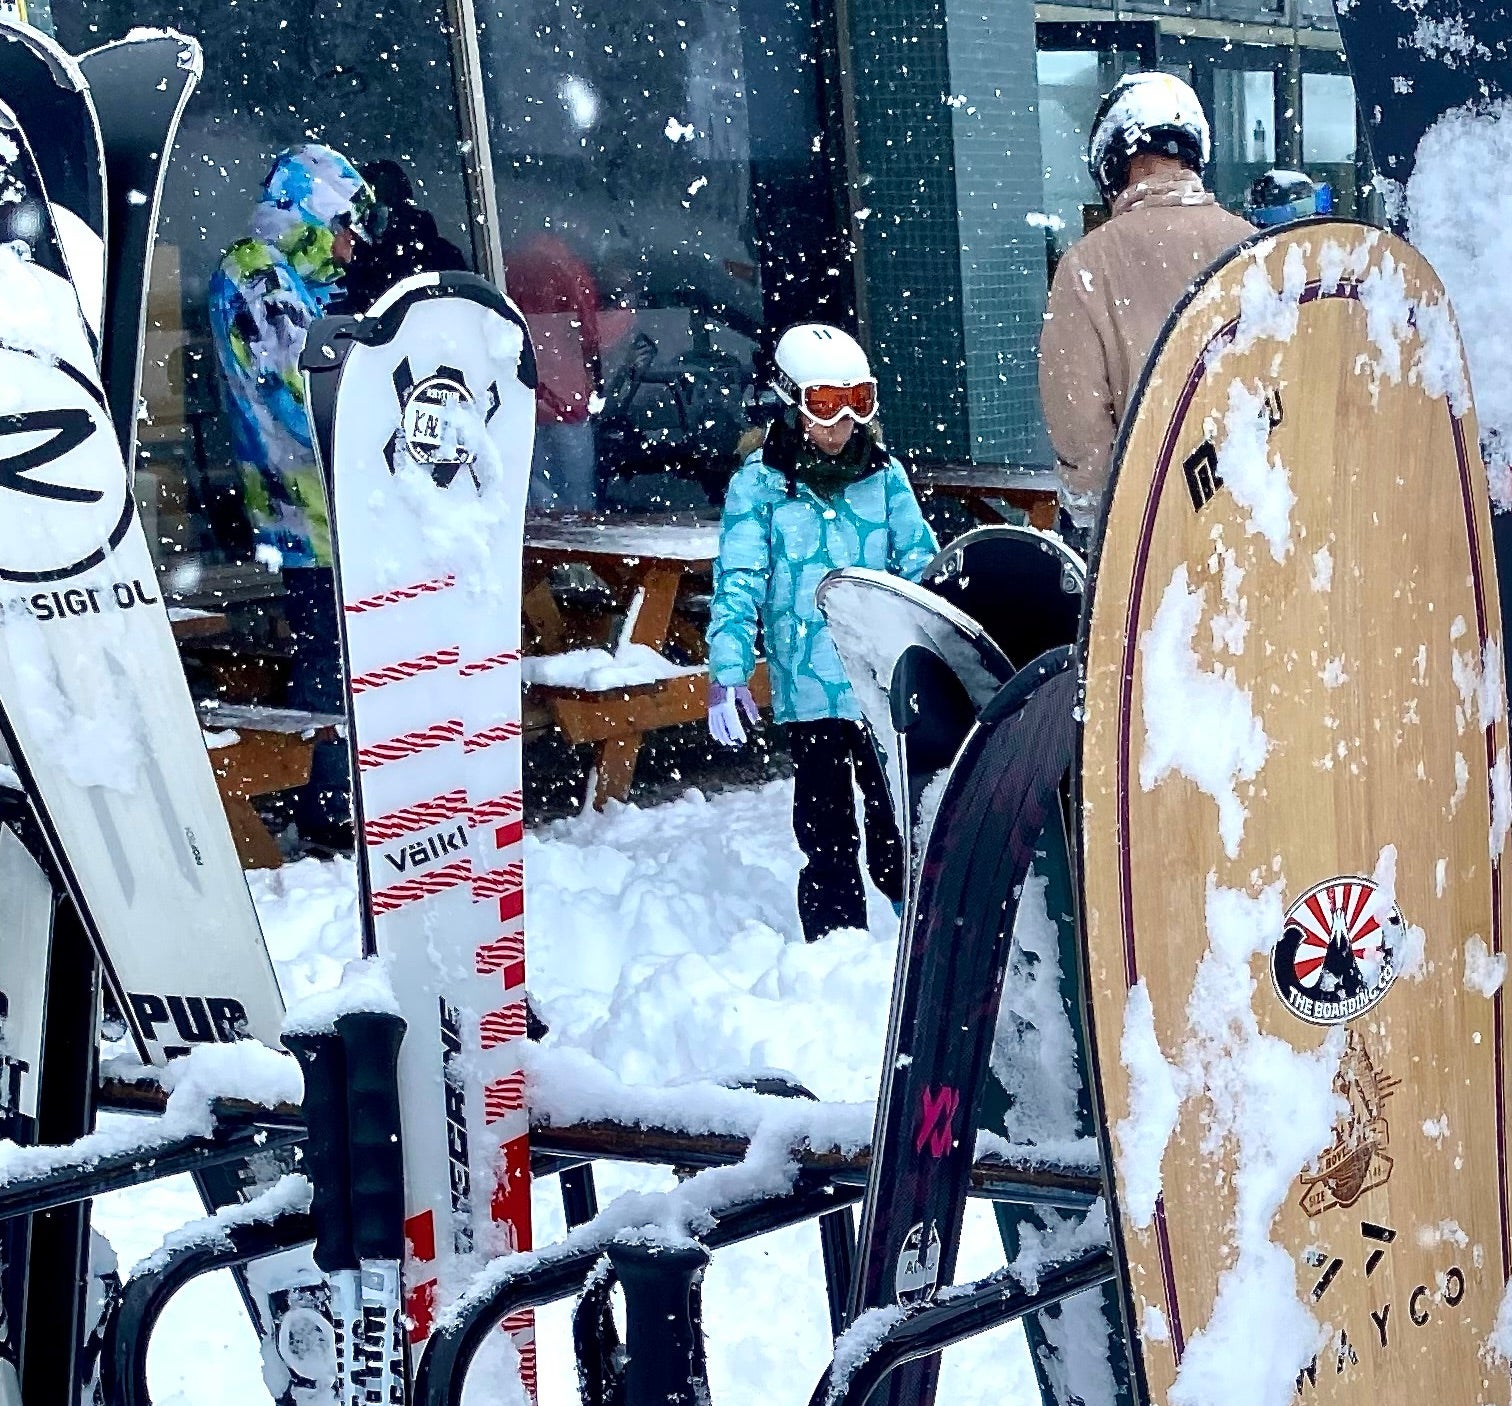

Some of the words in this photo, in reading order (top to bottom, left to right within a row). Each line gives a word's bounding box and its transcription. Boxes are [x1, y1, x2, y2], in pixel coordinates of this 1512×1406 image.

[384, 824, 469, 872] Völkl
[1289, 986, 1313, 1016] THE
[1313, 989, 1380, 1018] BOARDING
